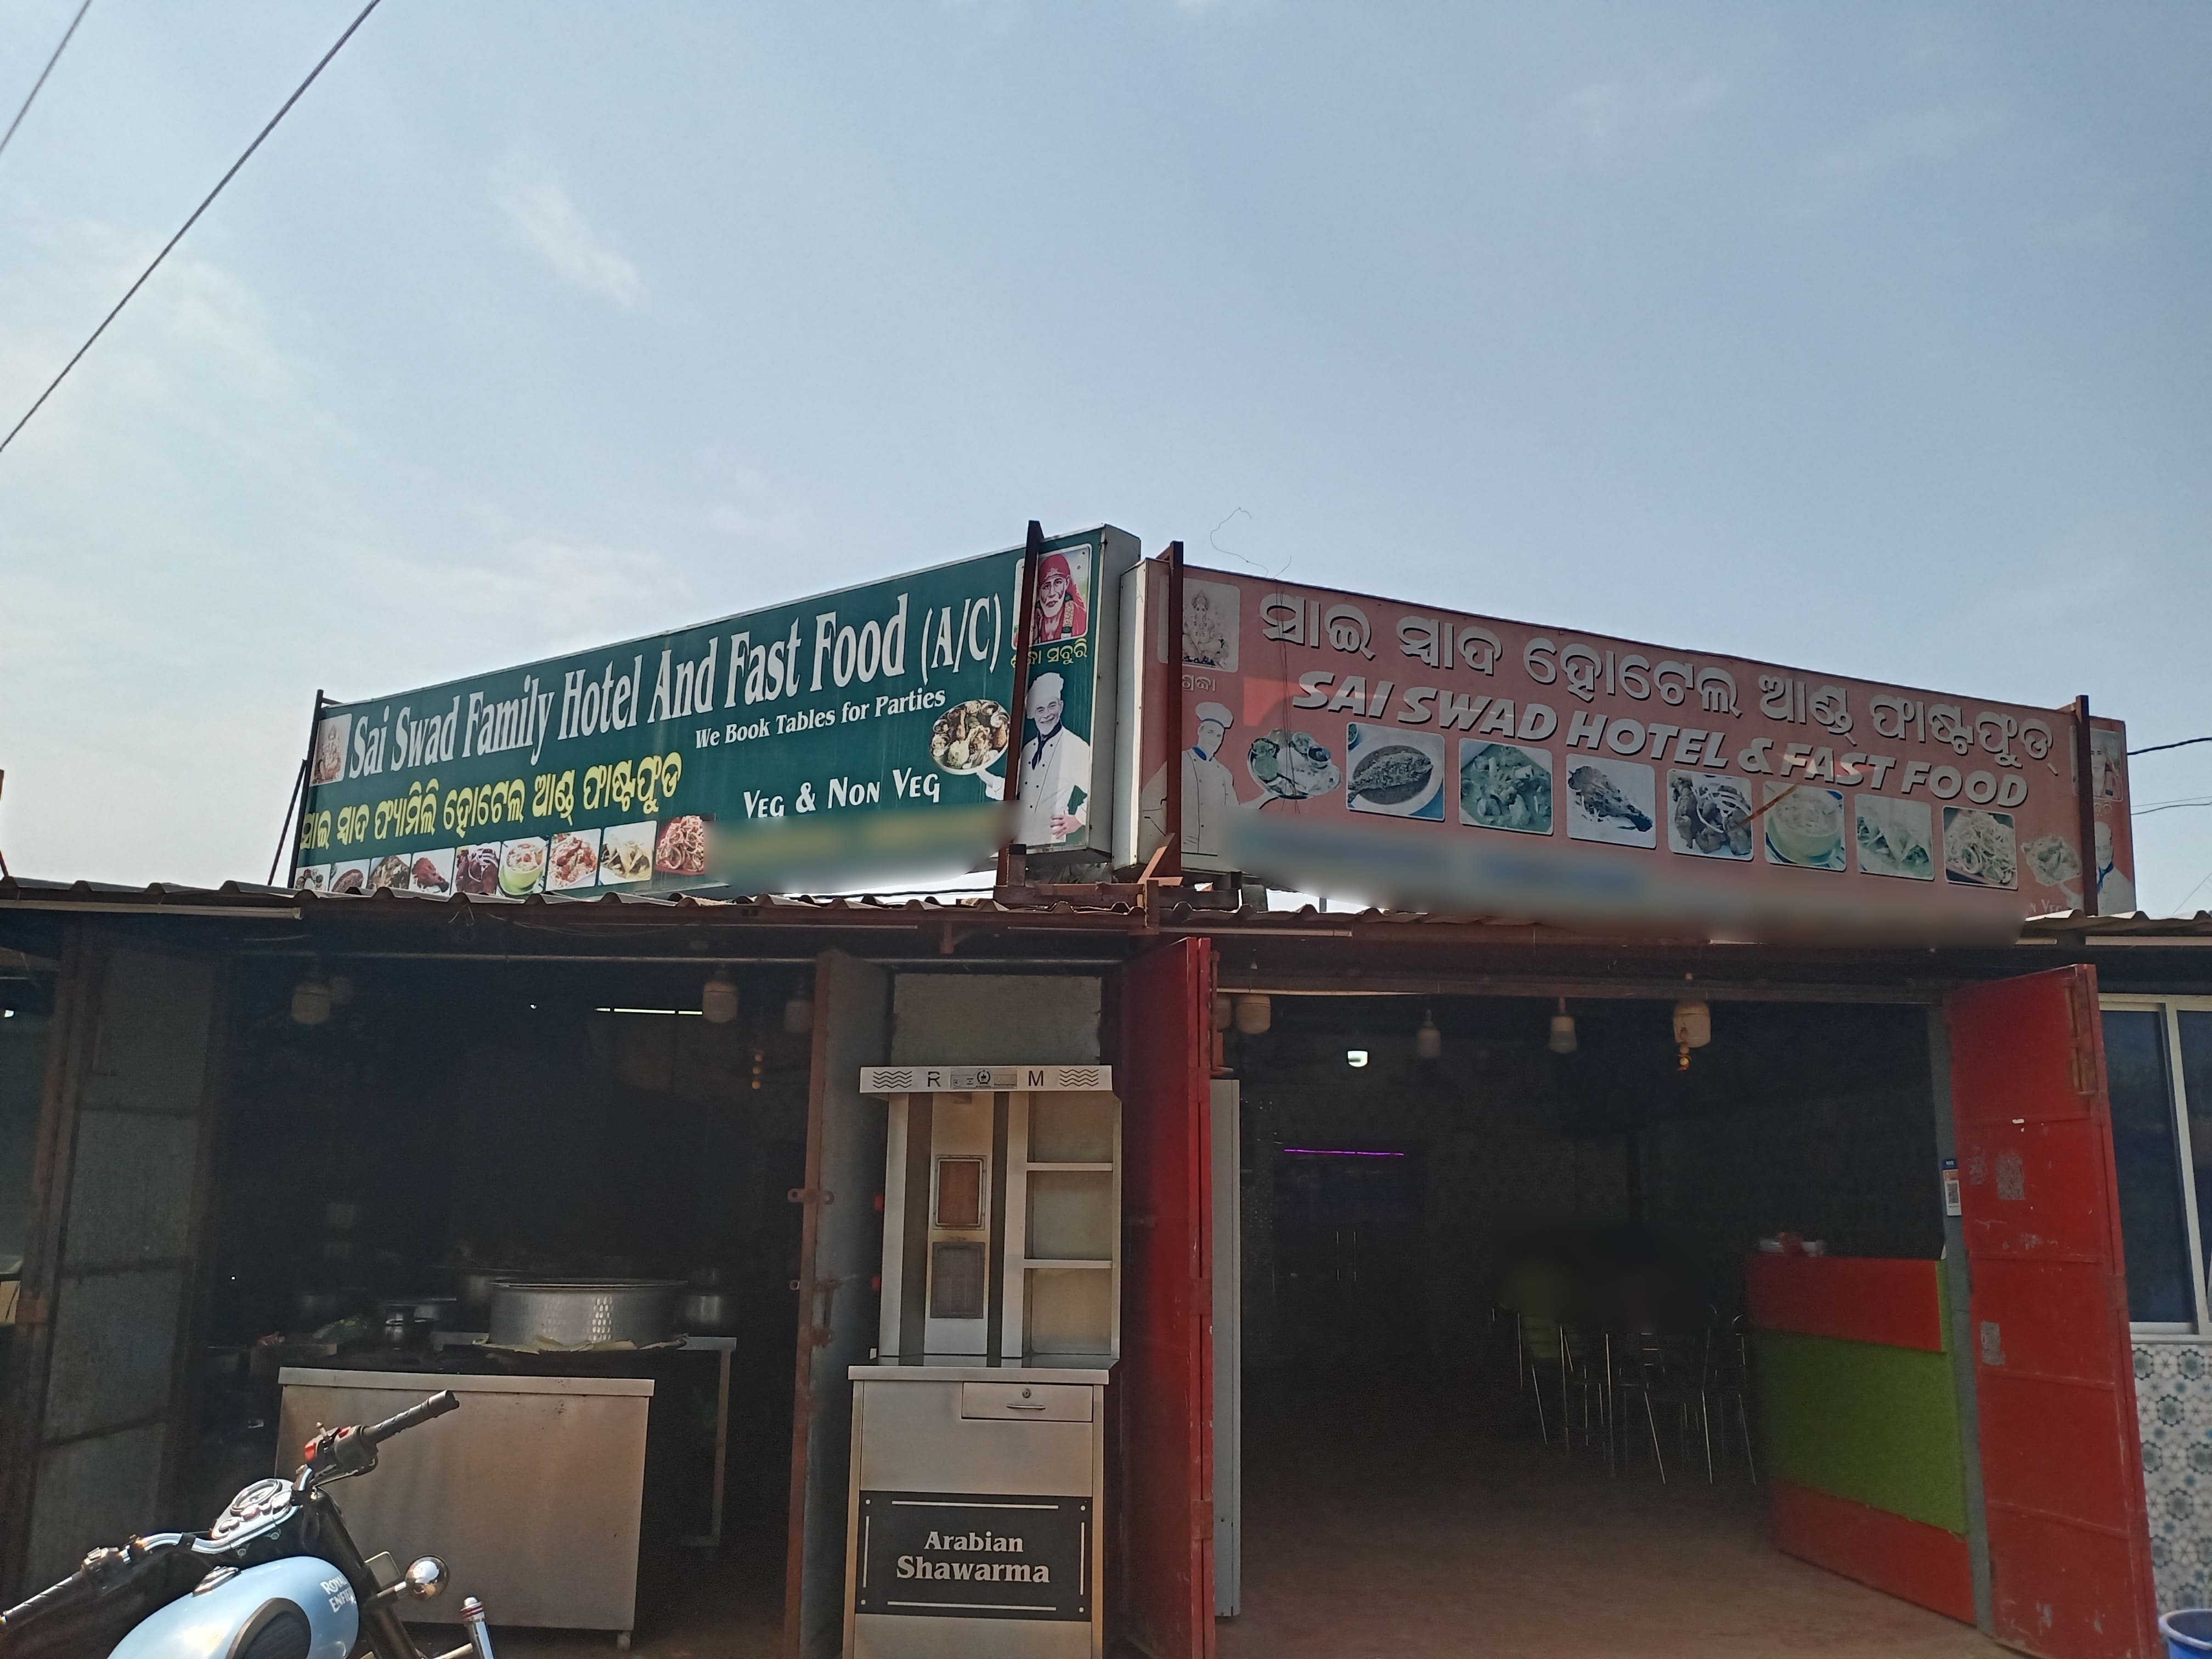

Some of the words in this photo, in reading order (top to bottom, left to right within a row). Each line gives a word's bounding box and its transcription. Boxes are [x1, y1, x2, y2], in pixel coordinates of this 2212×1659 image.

[1260, 592, 1375, 661] ସାଇ
[1047, 638, 1087, 665] ସବୁରି
[349, 706, 388, 779] Sai
[390, 695, 460, 774] Swad
[462, 674, 555, 765] Family
[557, 654, 643, 741] Hotel
[647, 636, 718, 724] And
[725, 617, 802, 708] Fast
[810, 592, 909, 692] Food
[921, 592, 1002, 685] (A/C)
[696, 723, 720, 748] We
[725, 716, 770, 745] Book
[776, 708, 836, 736] Tables
[840, 699, 870, 723] for
[874, 688, 946, 717] Parties
[1292, 670, 1395, 719] SAI
[1397, 686, 1558, 741] SWAD
[1566, 710, 1729, 769] HOTEL
[1737, 737, 1773, 775] &
[1781, 743, 1897, 790] FAST
[1901, 760, 2028, 808] FOOD
[795, 782, 815, 812] &
[828, 776, 879, 808] NON
[892, 767, 940, 803] VEG
[927, 1071, 941, 1087] R
[1028, 1070, 1043, 1087] M
[923, 1531, 1024, 1553] Arabian
[320, 1575, 347, 1595] ROYAL
[896, 1555, 1050, 1583] Shawarma
